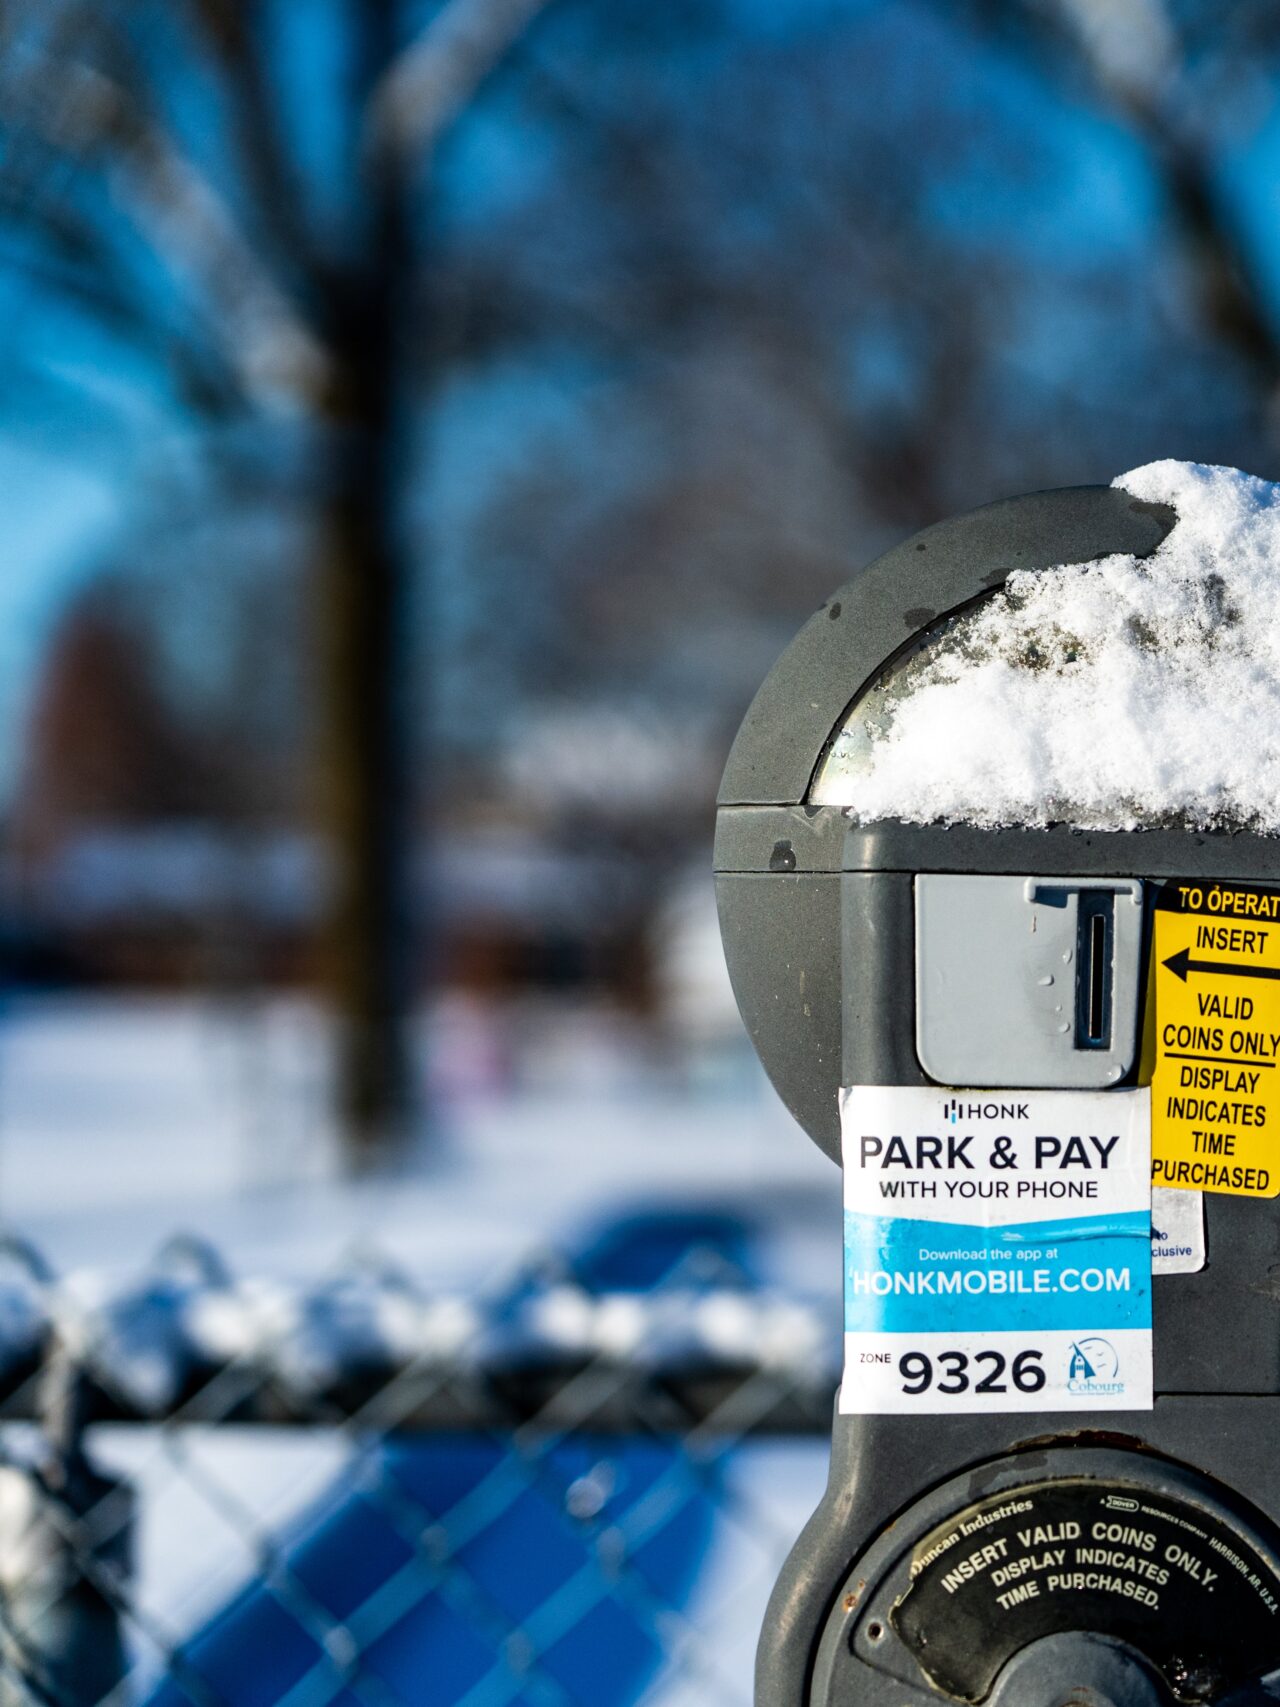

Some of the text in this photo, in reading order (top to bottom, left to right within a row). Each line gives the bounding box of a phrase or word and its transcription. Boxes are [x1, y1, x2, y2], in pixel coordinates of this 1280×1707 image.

[1178, 886, 1203, 909] TO
[1196, 925, 1269, 954] INSERT
[1198, 993, 1254, 1020] VALID
[1163, 1024, 1224, 1051] COINS
[1180, 1066, 1261, 1095] DISPLAY
[968, 1103, 1029, 1119] HONK
[1166, 1097, 1267, 1127] INDICATES
[860, 1135, 1121, 1170] PARK & PAY
[1191, 1130, 1236, 1156] TIME
[1151, 1158, 1270, 1191] PURCHASED
[880, 1180, 1098, 1199] WITH YOUR PHONE
[919, 1248, 1058, 1263] Download the app at
[1151, 1245, 1192, 1257] clusive
[852, 1267, 1131, 1295] HONKMOBILE.COM
[860, 1349, 1047, 1395] ZONE 9326
[1067, 1379, 1125, 1393] Cobourg
[910, 1499, 1034, 1577] Duncan Industries
[940, 1521, 1218, 1594] INSERT VALID COINS ONLY.
[990, 1548, 1170, 1587] DISPLAY INDICATES
[1208, 1536, 1250, 1579] HARRISON,
[996, 1572, 1160, 1611] TIME PURCHASED.
